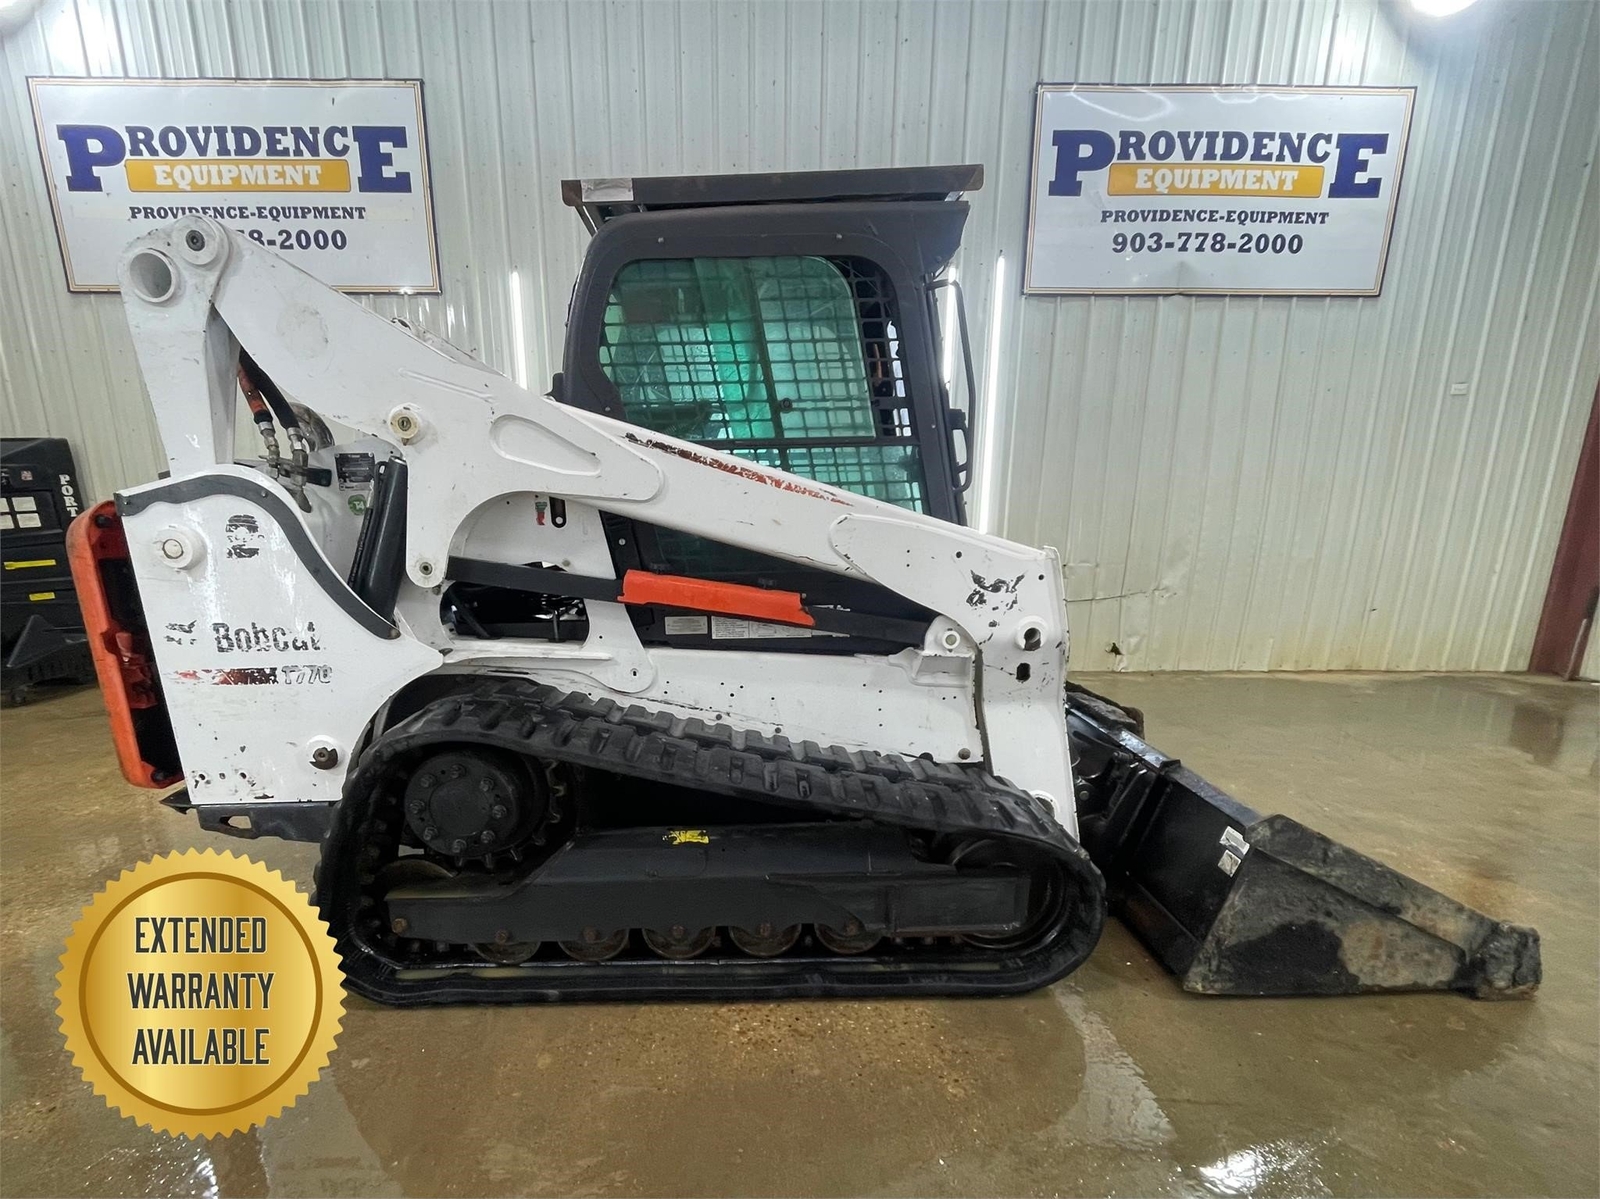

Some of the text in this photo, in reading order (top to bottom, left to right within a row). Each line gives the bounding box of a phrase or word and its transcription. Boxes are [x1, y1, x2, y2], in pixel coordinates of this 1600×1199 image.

[55, 124, 412, 193] PROVIDENCE
[1048, 130, 1389, 198] PROVIDENCE
[153, 164, 322, 191] EQUIPMENT
[1135, 169, 1300, 194] EQUIPMENT
[1100, 210, 1330, 226] PROVIDENCE-EQUIPMENT
[1112, 232, 1304, 255] 903-778-2000
[212, 621, 321, 652] Bobcat
